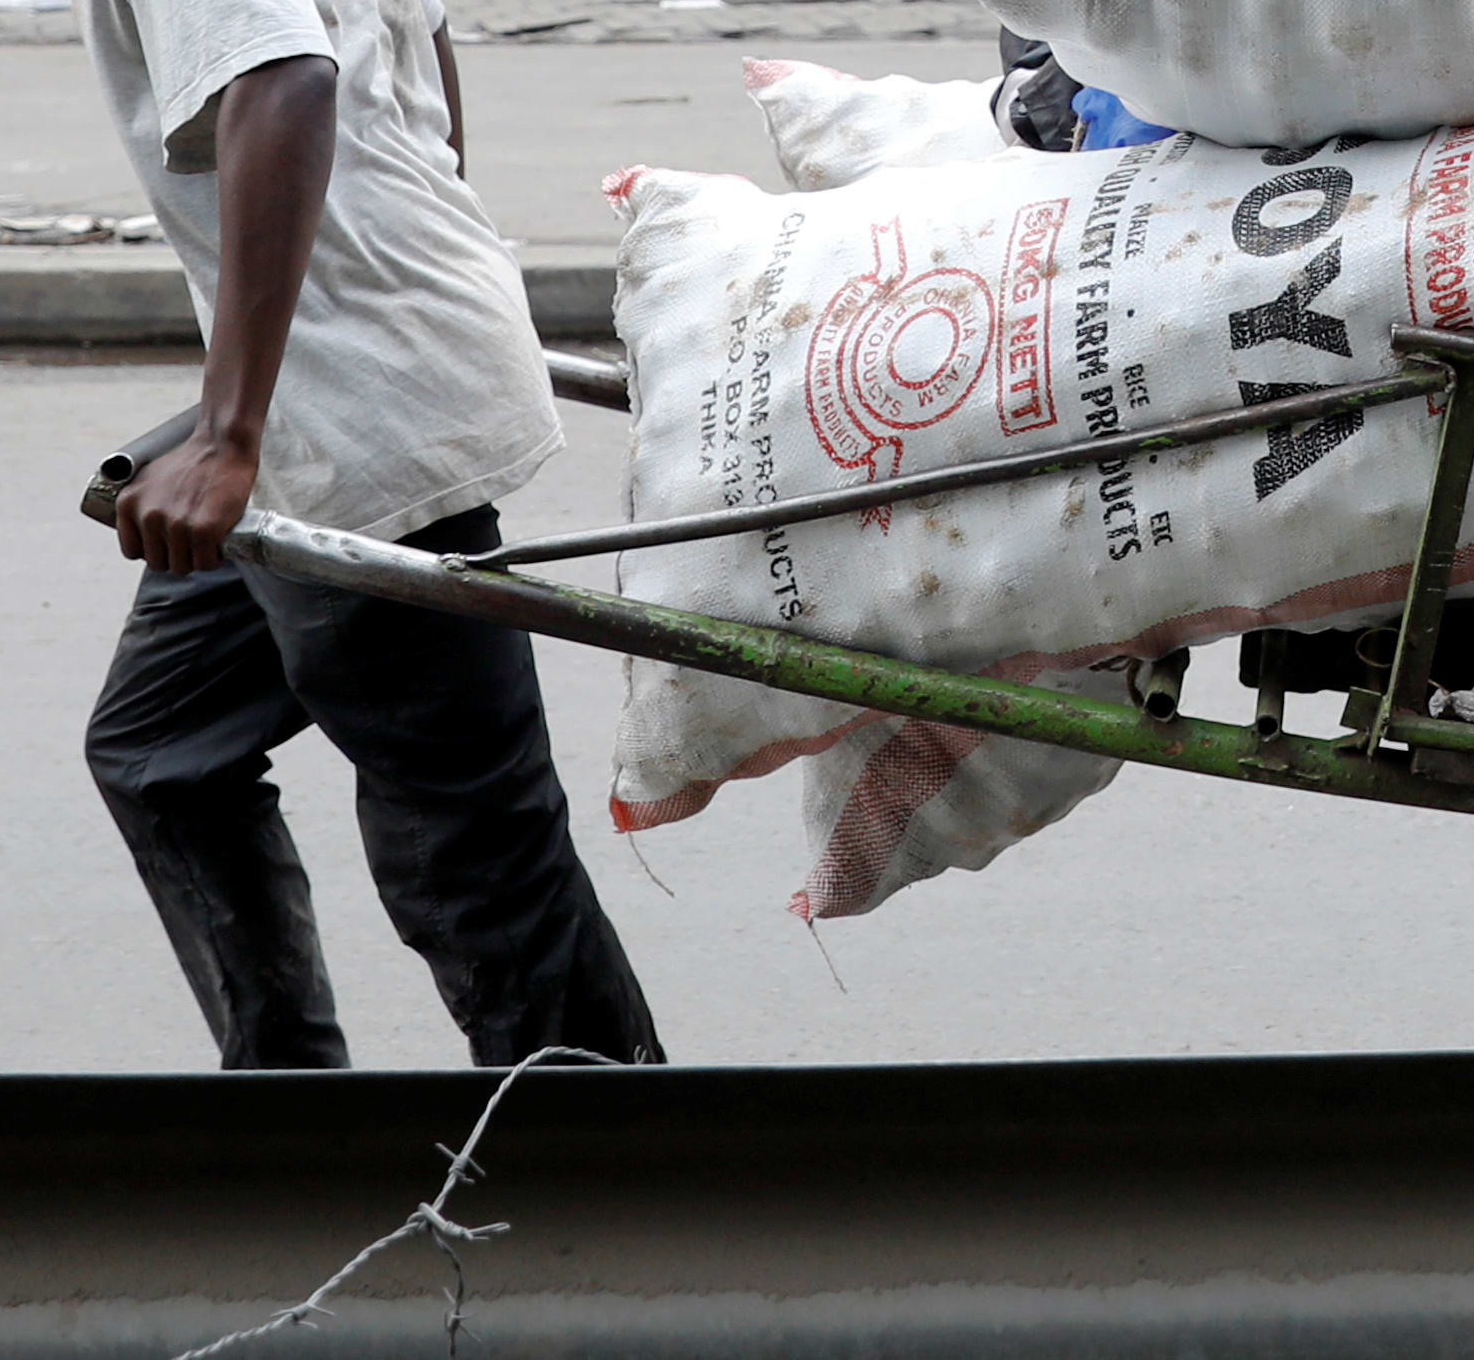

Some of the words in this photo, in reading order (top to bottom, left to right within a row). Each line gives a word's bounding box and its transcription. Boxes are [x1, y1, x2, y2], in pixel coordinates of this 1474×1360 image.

[1078, 166, 1145, 274] QUALITY
[1428, 153, 1471, 222] FARM
[1123, 202, 1153, 262] MAIZE
[1074, 279, 1112, 382] FARM
[1229, 111, 1370, 503] OYA
[747, 329, 773, 428] FARM
[816, 349, 838, 388] FARM
[860, 304, 908, 420] PRODUCTS
[916, 352, 970, 409] FARM
[1009, 313, 1042, 421] NETT
[1122, 362, 1151, 410] RICE
[699, 381, 718, 476] THIKA
[723, 380, 743, 449] BOX
[817, 394, 861, 460] PRODUCTS
[722, 455, 744, 508] 313
[752, 435, 805, 623] PROUCTS
[1148, 510, 1174, 548] ETC
